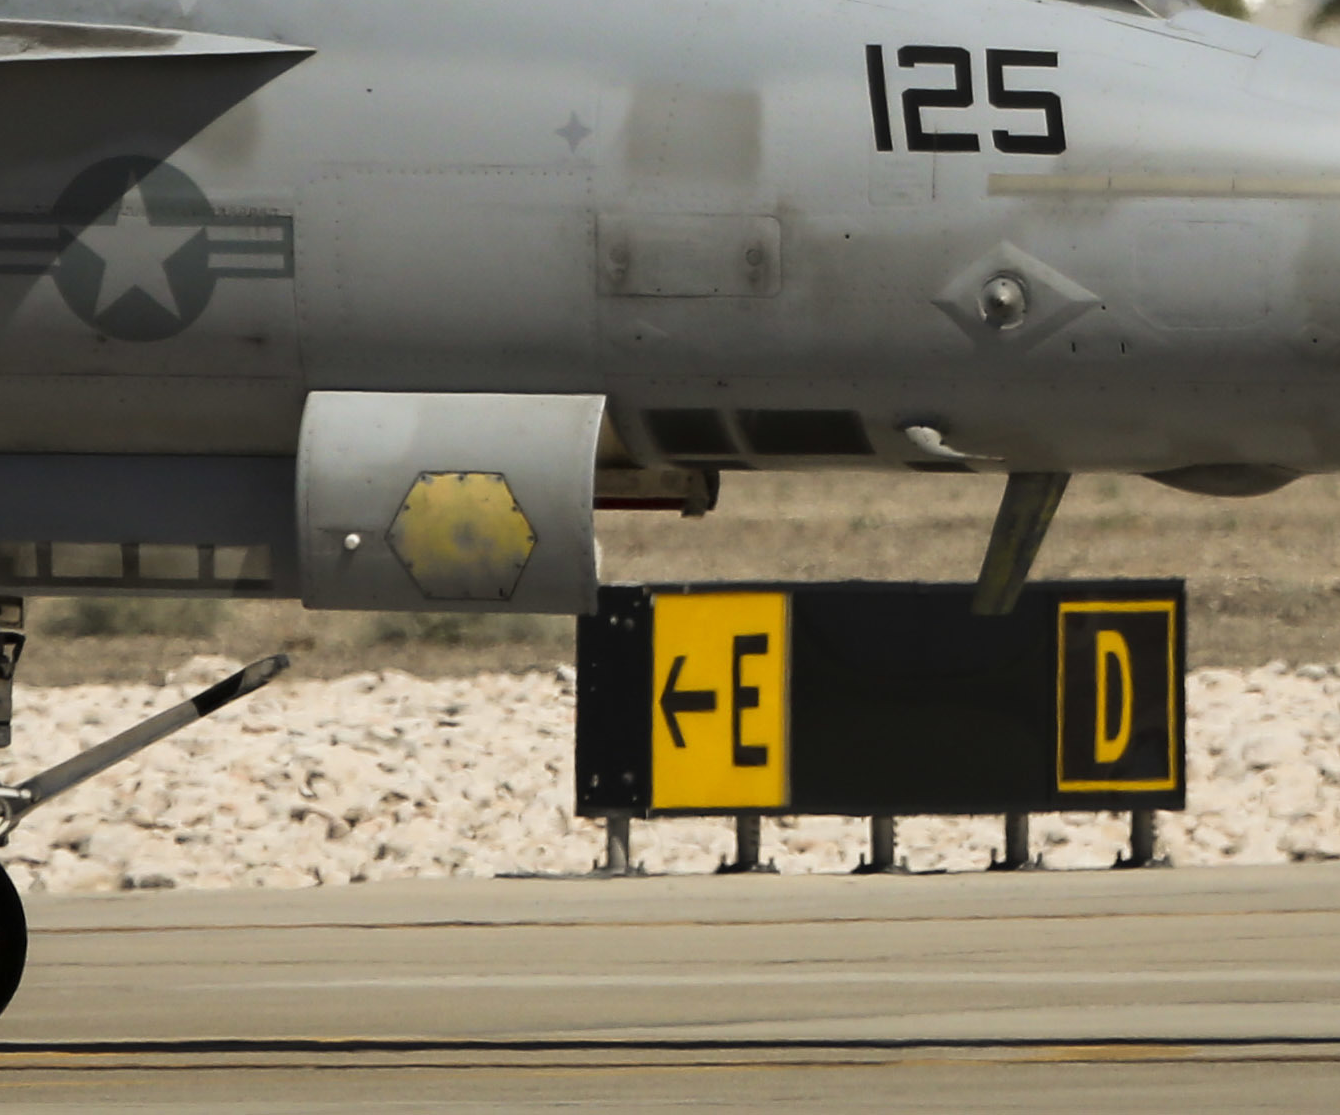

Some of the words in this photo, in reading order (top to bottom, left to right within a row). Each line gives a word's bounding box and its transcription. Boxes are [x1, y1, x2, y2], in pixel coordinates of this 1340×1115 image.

[865, 44, 1067, 155] 125
[731, 632, 769, 768] E
[1095, 630, 1134, 763] D
